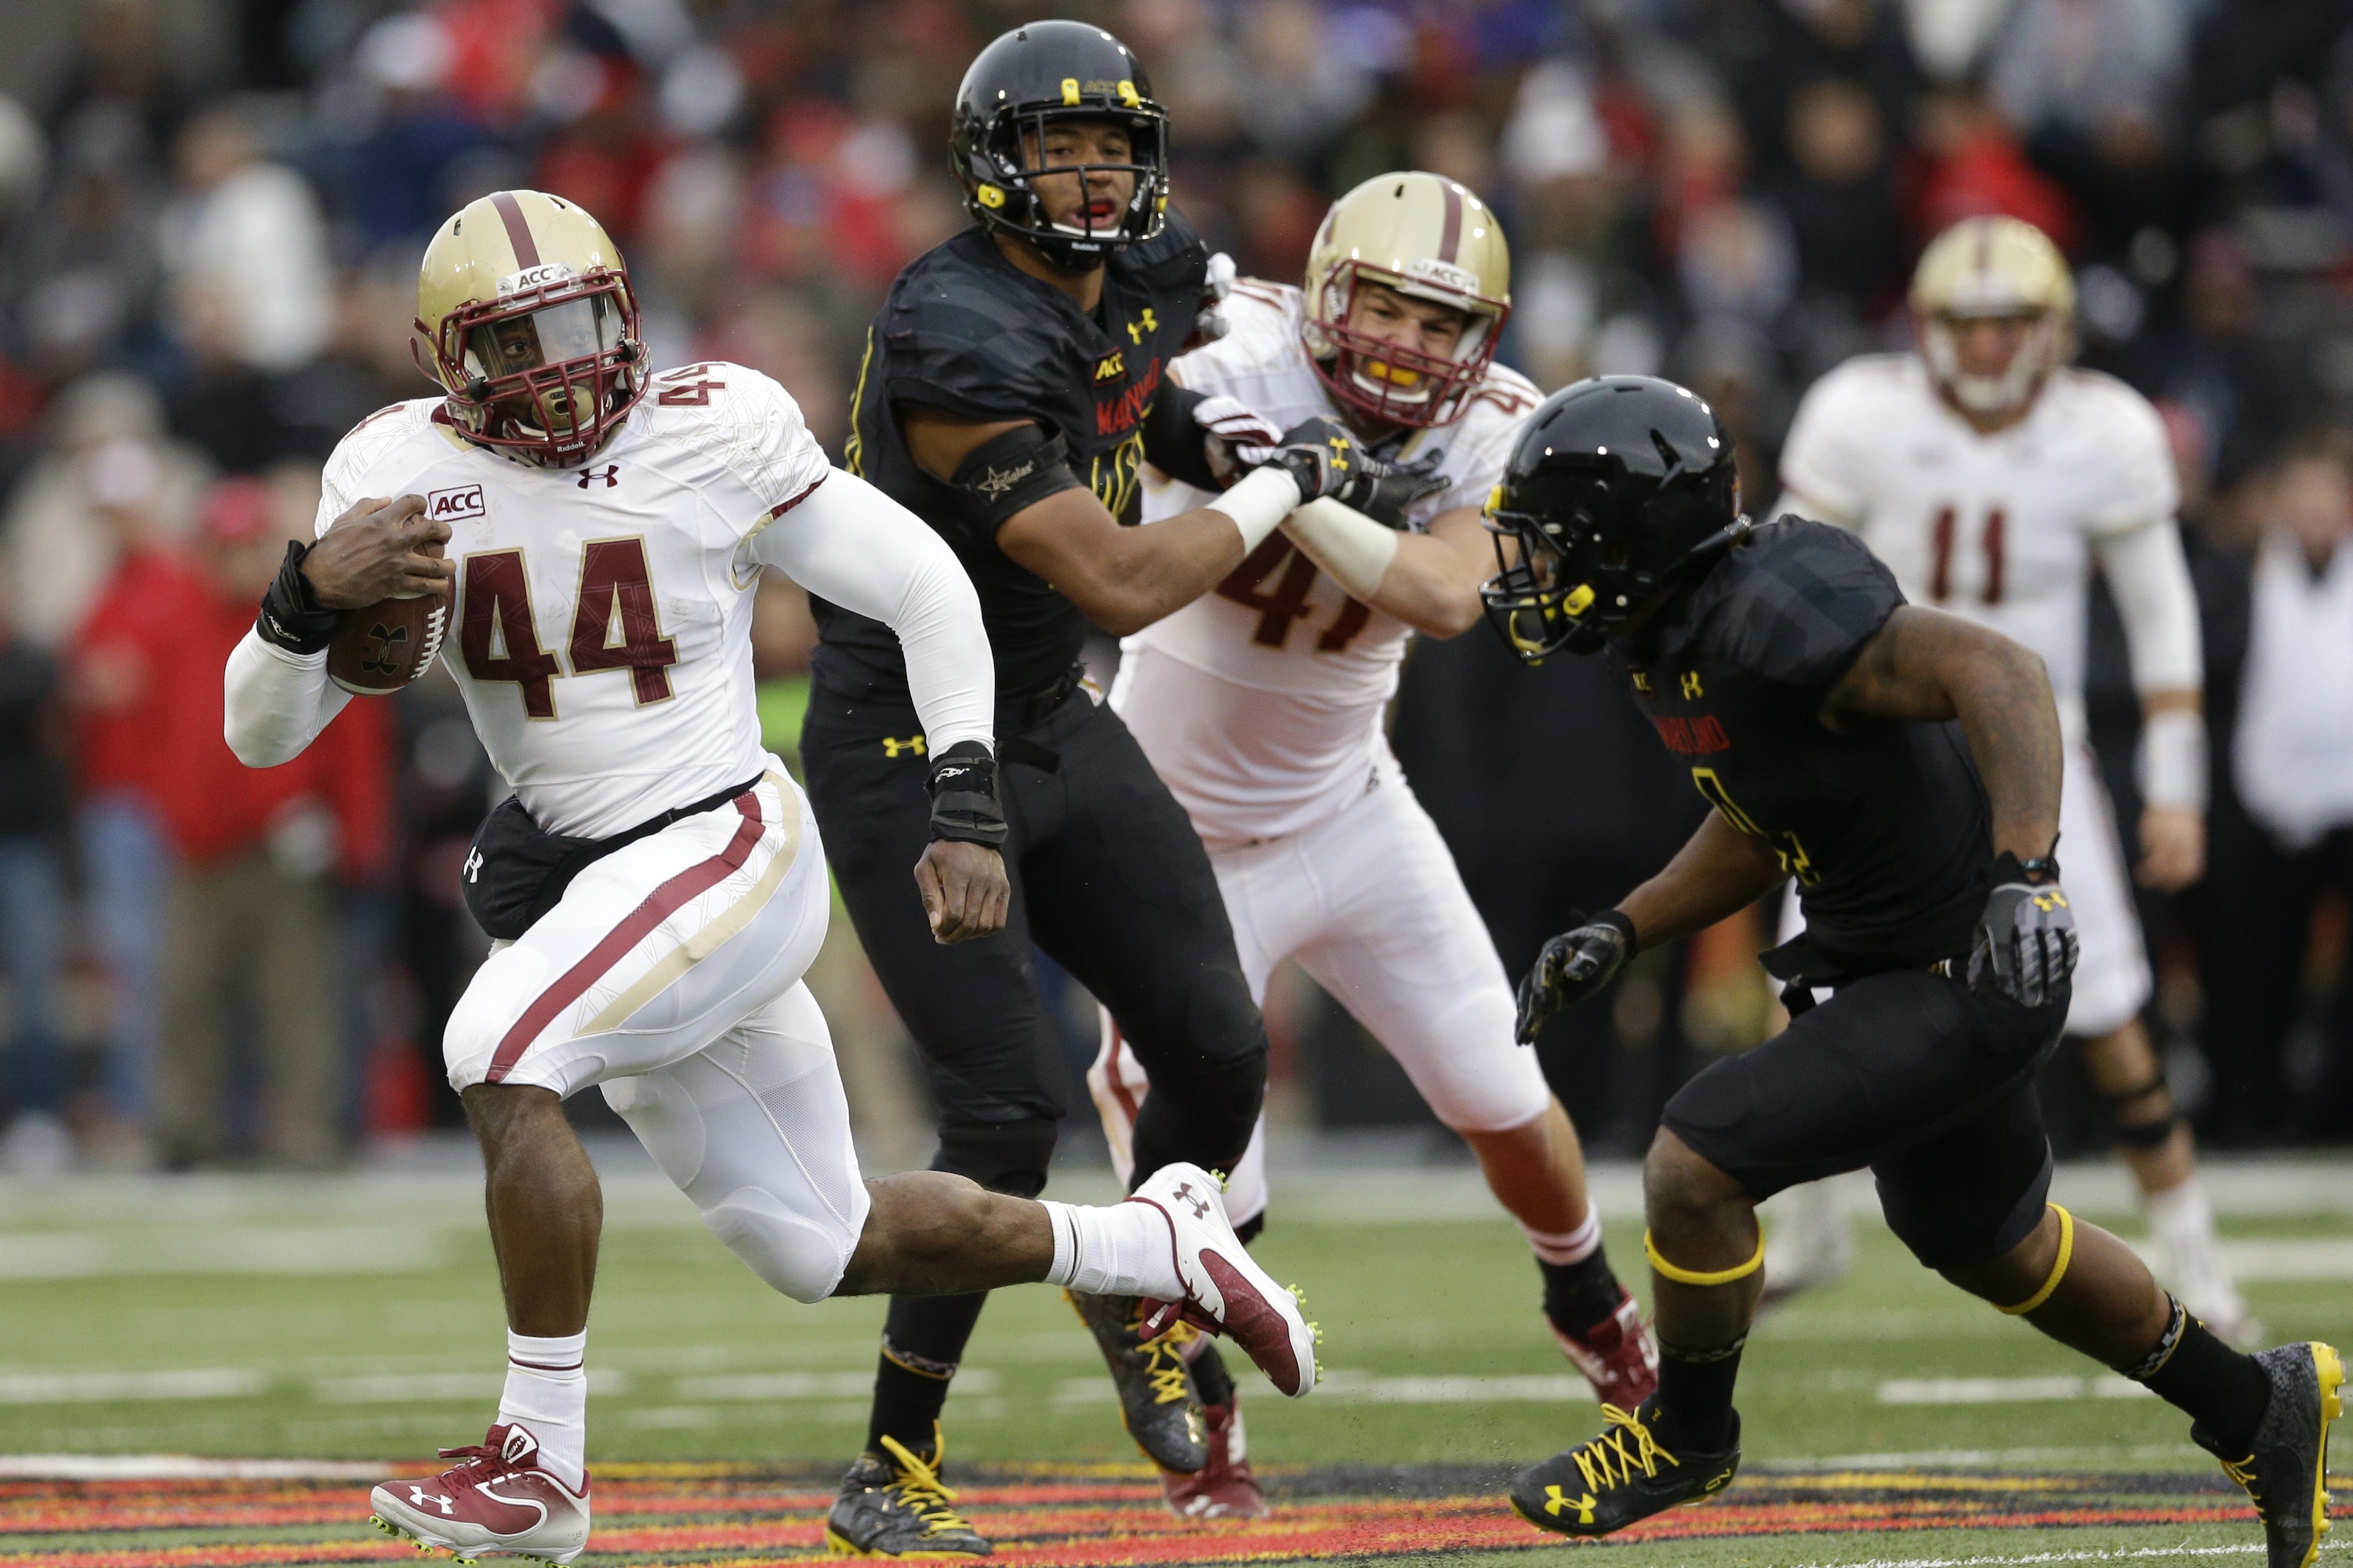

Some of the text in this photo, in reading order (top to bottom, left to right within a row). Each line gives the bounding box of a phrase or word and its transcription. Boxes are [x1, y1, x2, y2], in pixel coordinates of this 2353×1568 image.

[518, 267, 551, 289] ACC
[1095, 352, 1124, 379] ACC
[557, 441, 586, 453] Riddell
[434, 491, 481, 516] ACC
[1929, 506, 2007, 604] 11
[460, 534, 679, 722] 44
